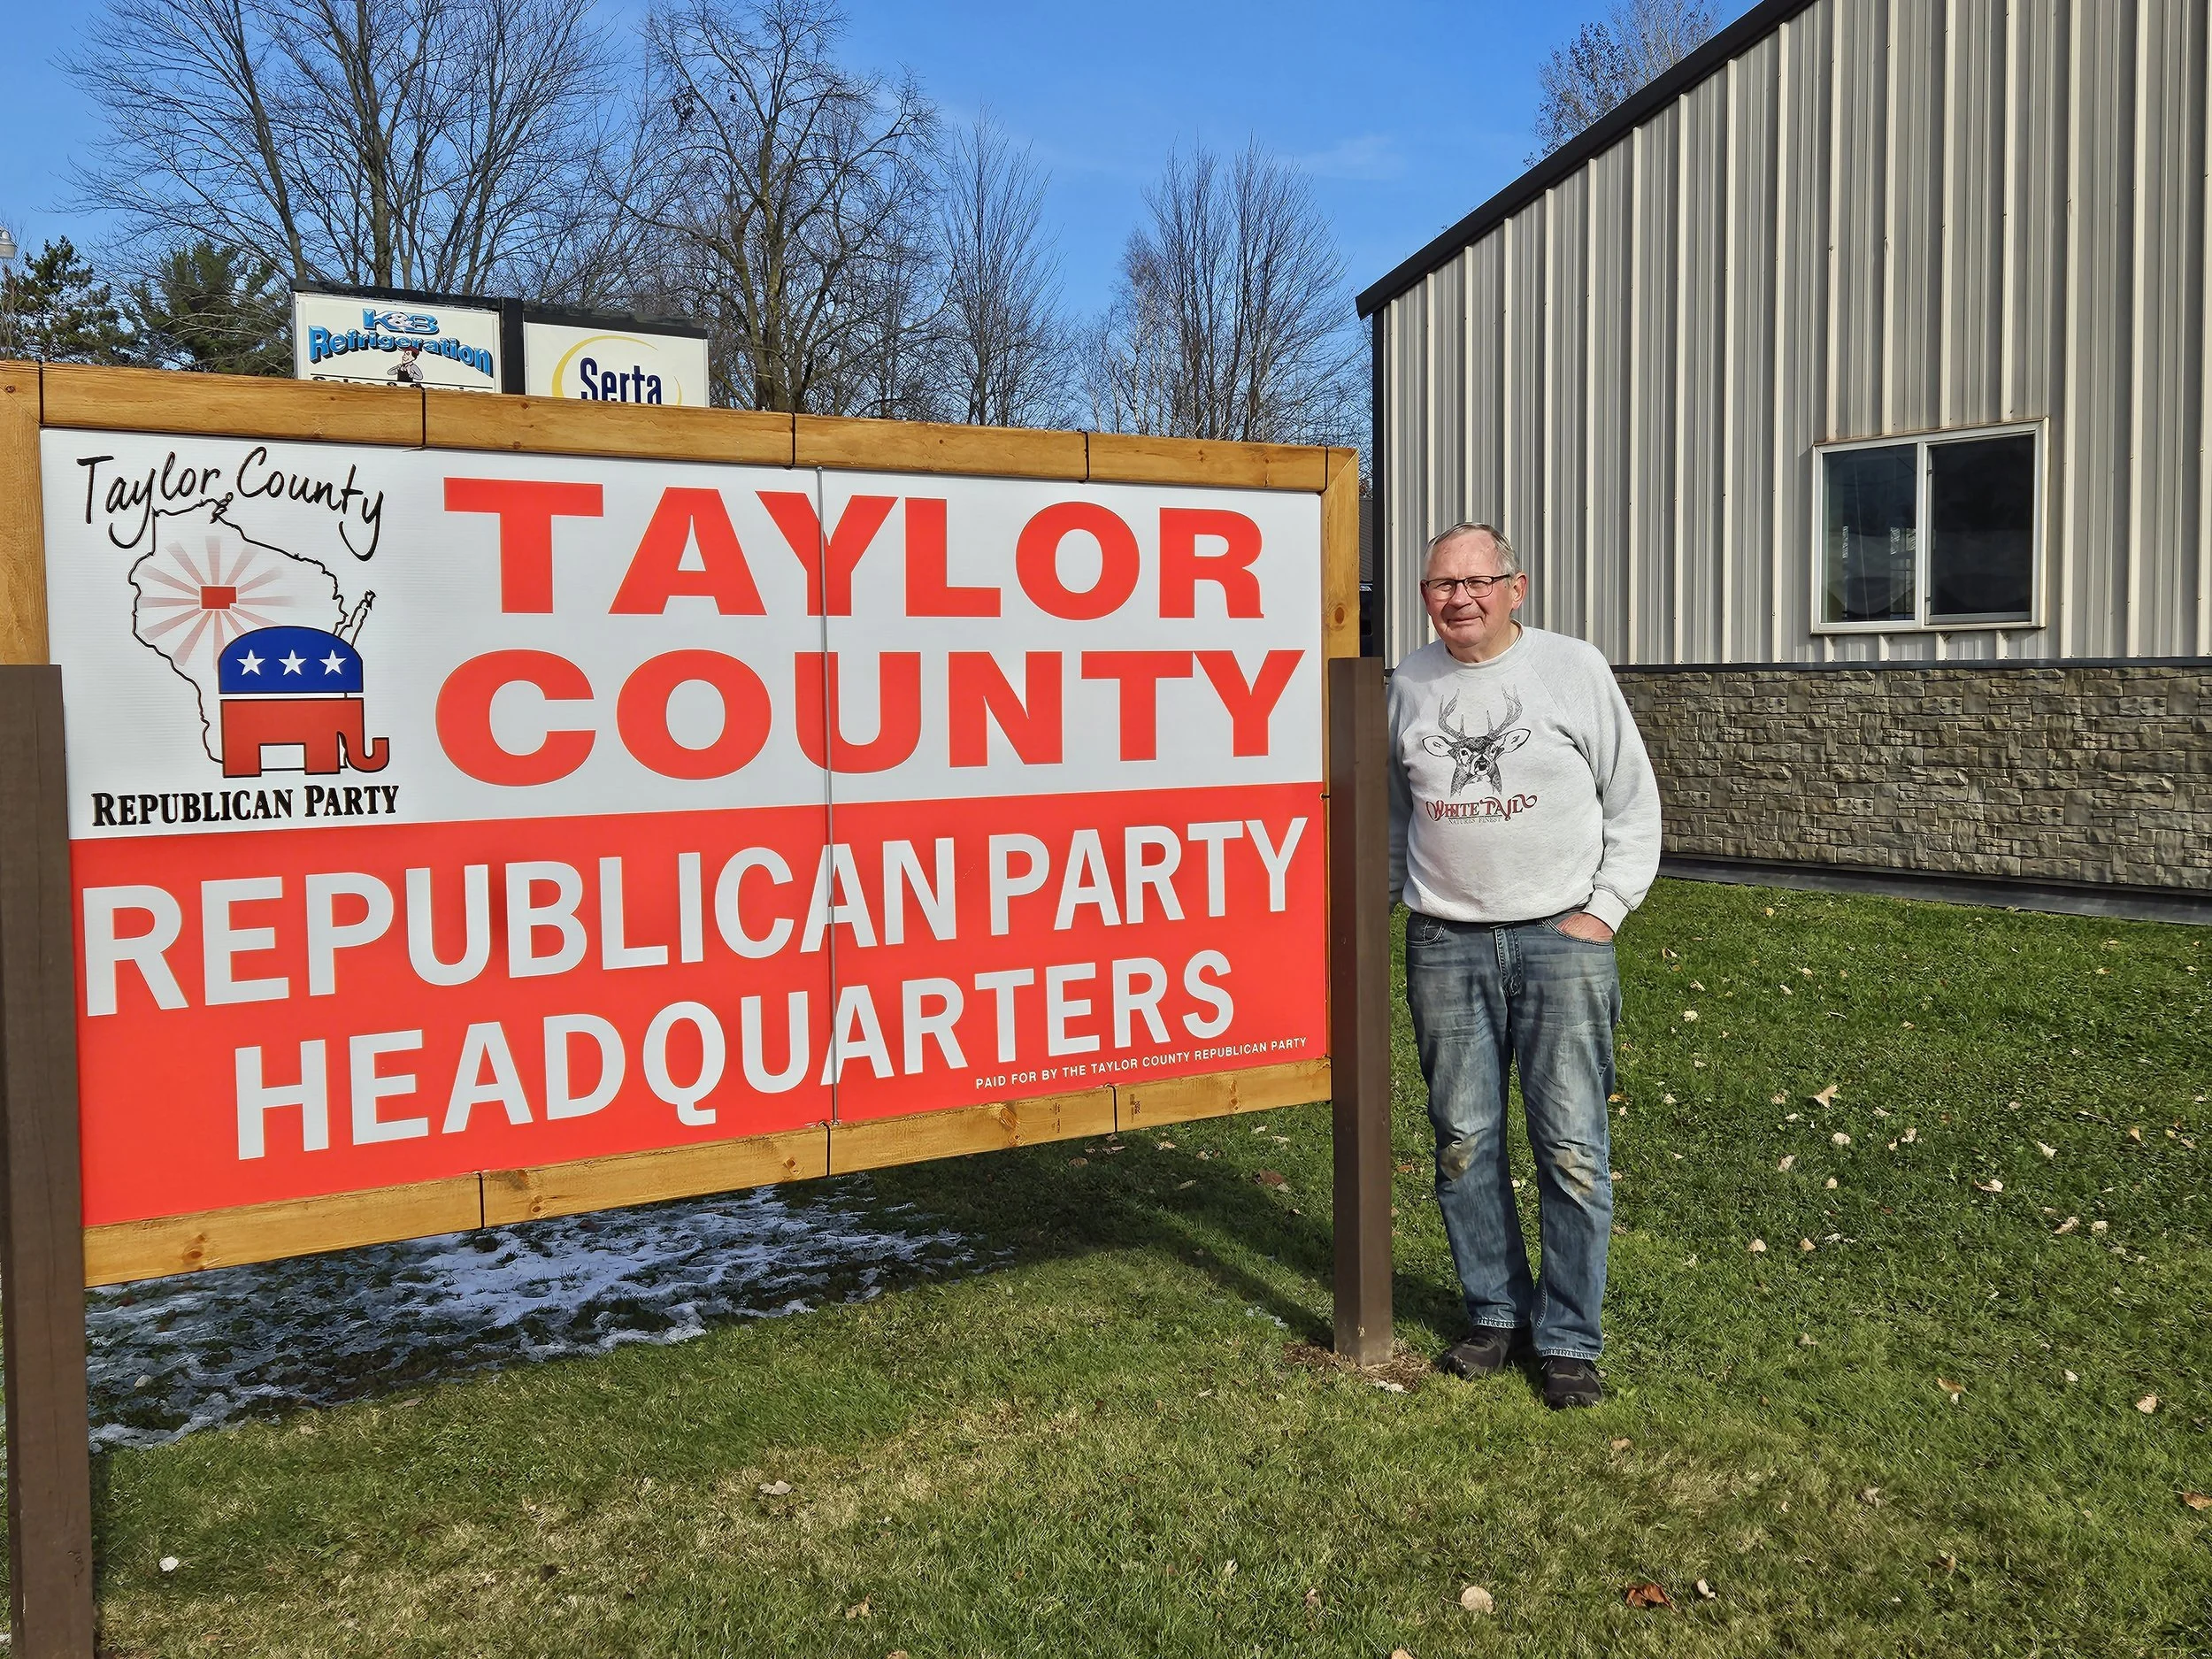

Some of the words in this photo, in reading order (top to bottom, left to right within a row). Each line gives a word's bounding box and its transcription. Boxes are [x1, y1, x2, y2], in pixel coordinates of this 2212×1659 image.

[308, 325, 494, 378] Refrigeration
[362, 308, 441, 335] K&B
[580, 357, 662, 404] Serta
[76, 451, 219, 549] Taylor
[236, 446, 384, 561] County
[442, 476, 1265, 621] TAYLOR
[434, 649, 1306, 787] COUNTY
[91, 788, 293, 827] REPUBLICAN
[303, 785, 400, 818] PARTY
[82, 837, 957, 1017] REPUBLICAN
[988, 817, 1309, 936] PARTY
[234, 949, 1234, 1160] HEADQUARTERS
[975, 1074, 1007, 1089] PAID
[1010, 1071, 1037, 1085] FOR
[1041, 1068, 1057, 1081] BY
[1062, 1064, 1087, 1079] THE
[1090, 1058, 1139, 1075] TAYLOR
[1141, 1050, 1191, 1067] COUNTY
[1194, 1041, 1267, 1061] REPUBLICAN
[1271, 1036, 1308, 1050] PARTY
